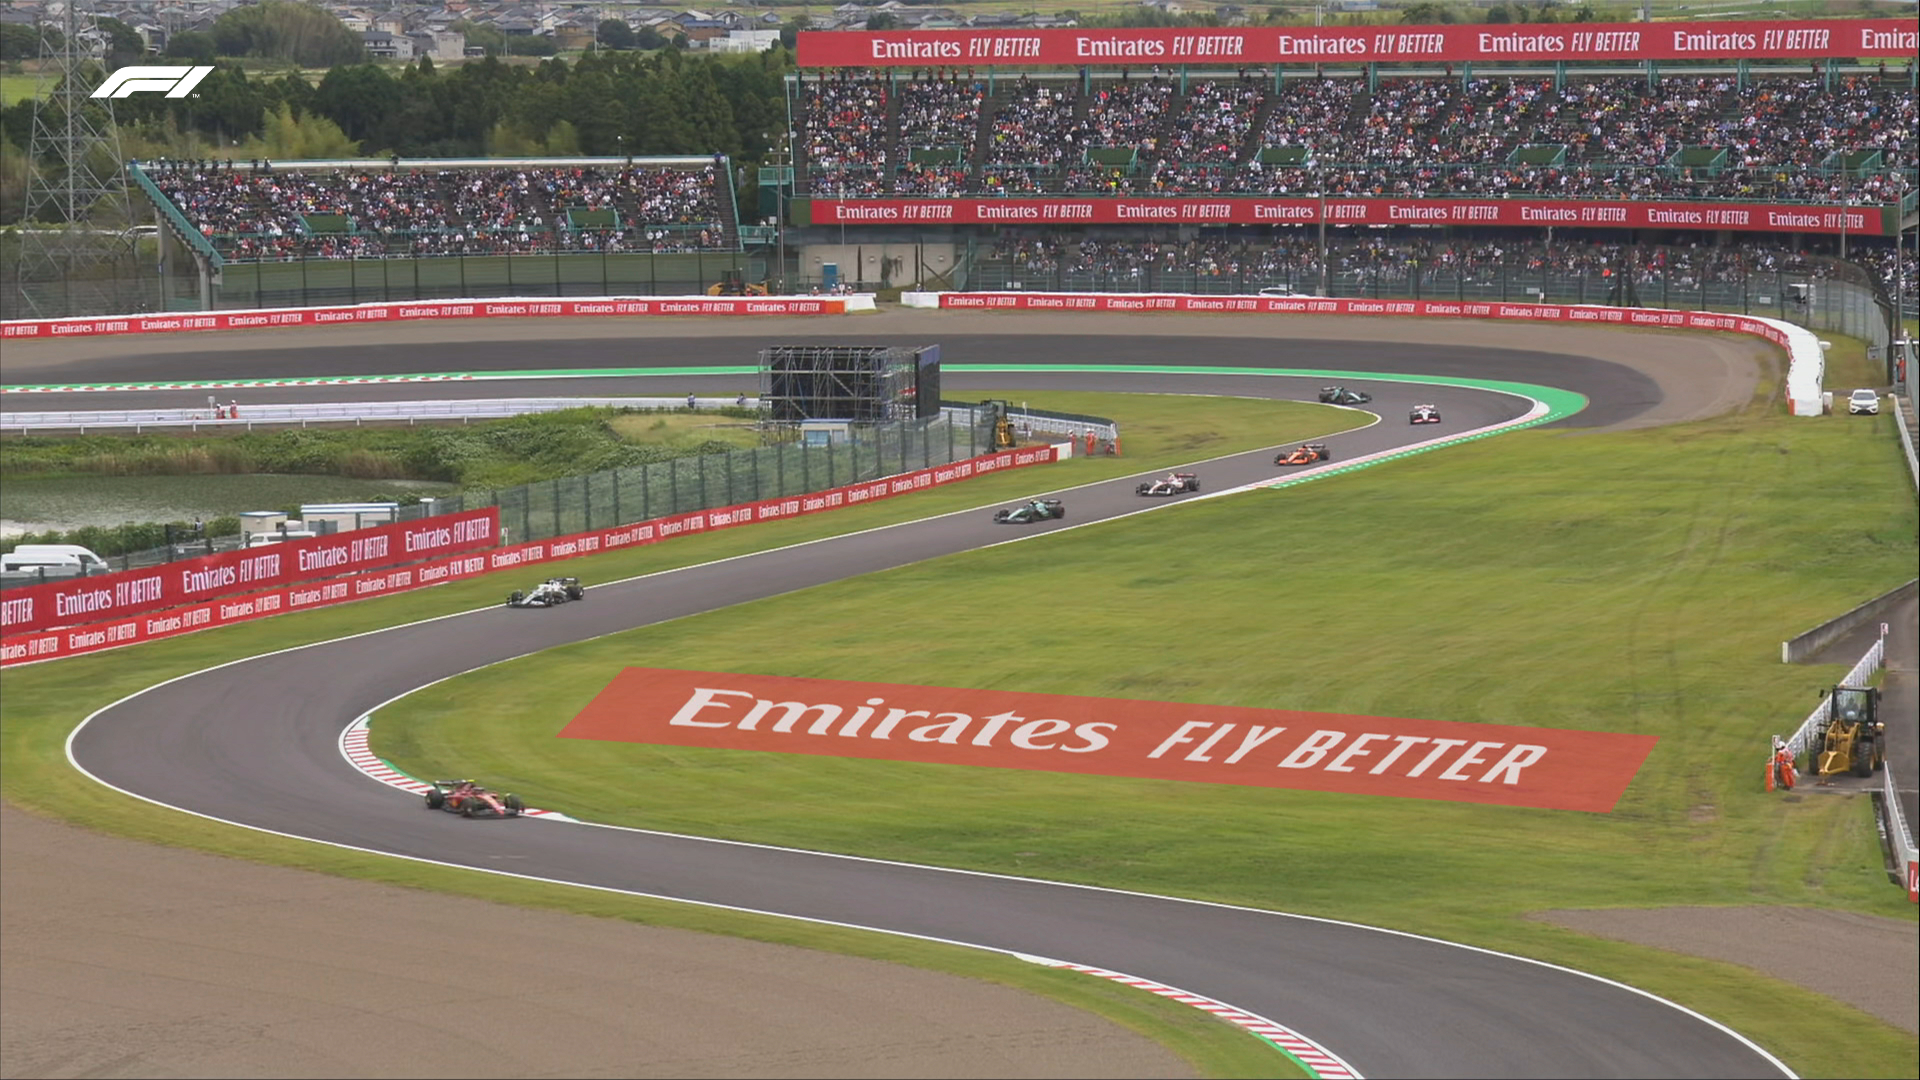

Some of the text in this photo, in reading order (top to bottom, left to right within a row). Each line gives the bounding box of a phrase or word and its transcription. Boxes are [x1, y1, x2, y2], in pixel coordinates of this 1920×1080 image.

[1076, 36, 1242, 56] Emirates FLY BETTER
[1279, 34, 1443, 54] Emirates FLY BETTER
[1479, 32, 1639, 52] Emirates FLY BETTER
[1674, 30, 1828, 50] Emirates FLY BETTER
[872, 38, 1040, 58] Emirates FLY BETTER
[836, 205, 952, 219] Emirates FLY BETTER
[977, 205, 1091, 219] Emirates FLY BETTER
[1116, 204, 1230, 218] Emirates FLY BETTER
[1254, 205, 1365, 219] Emirates LY BETTER
[1389, 206, 1498, 220] Emirates FLY BETTER
[1521, 207, 1626, 222] Emirates FLY BETTER
[1648, 209, 1748, 225] Emirates FLY BETTER
[1768, 212, 1819, 227] Emirates
[1824, 214, 1835, 228] FLY
[660, 303, 734, 312] Emirates FLY BETTER
[747, 303, 819, 312] Emirates FLY BETTER
[948, 297, 984, 306] Emirates
[1027, 298, 1062, 307] Emirates
[1107, 299, 1143, 309] Emirates
[1187, 300, 1223, 309] Emirates
[1268, 301, 1304, 311] Emirates
[1348, 303, 1383, 312] Emirates
[314, 309, 386, 322] Emirates FLY BETTER
[399, 306, 473, 318] Emirates FLY BETTER
[486, 305, 561, 315] Emirates FLY BETTER
[574, 304, 648, 314] Emirates FLY BETTER
[1425, 304, 1459, 314] Emirates
[141, 318, 215, 330] Emirates FLY BETTER
[228, 314, 302, 327] Emirates FLY BETTER
[4, 326, 38, 336] FLY BETTER
[51, 322, 128, 334] Emirates FLY BETTER
[405, 517, 489, 552] Emirates FLY BETTER
[298, 535, 387, 571] Emirates FLY BETTER
[183, 554, 279, 593] Emirates FLY BETTER
[419, 566, 447, 583] Emirates
[450, 561, 462, 576] FLY
[356, 578, 385, 595] Emirates
[56, 577, 160, 616] Emirates FLY BETTER
[289, 590, 320, 607] Emirates
[1, 598, 32, 625] BETTER
[220, 603, 252, 620] Emirates
[147, 617, 180, 635] Emirates
[69, 632, 104, 650] Emirates
[670, 688, 1547, 785] Emirates FLY BETTER
